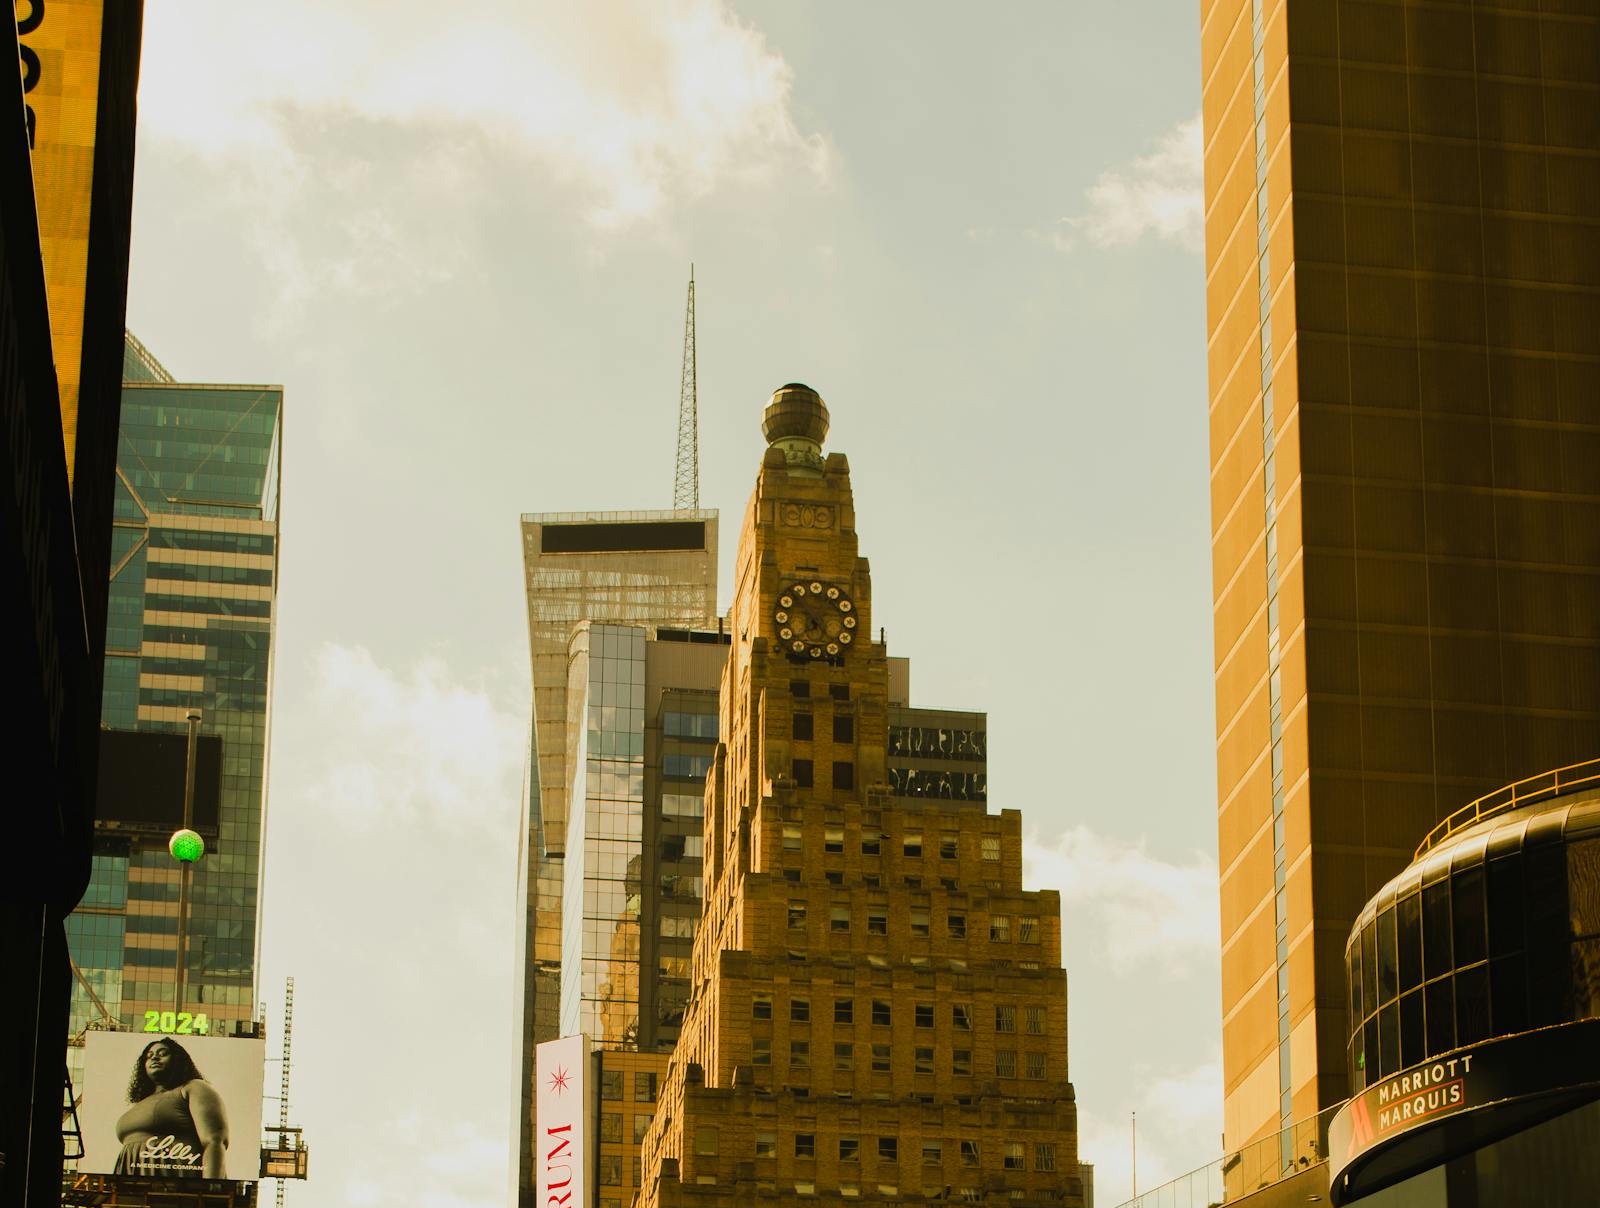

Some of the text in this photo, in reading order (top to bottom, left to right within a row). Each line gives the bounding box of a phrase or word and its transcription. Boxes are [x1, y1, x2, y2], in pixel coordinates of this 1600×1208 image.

[144, 1010, 209, 1034] 2024
[1379, 1055, 1473, 1105] MARRIOTT
[1380, 1084, 1461, 1130] MARQUIS
[141, 1134, 201, 1164] Lilly
